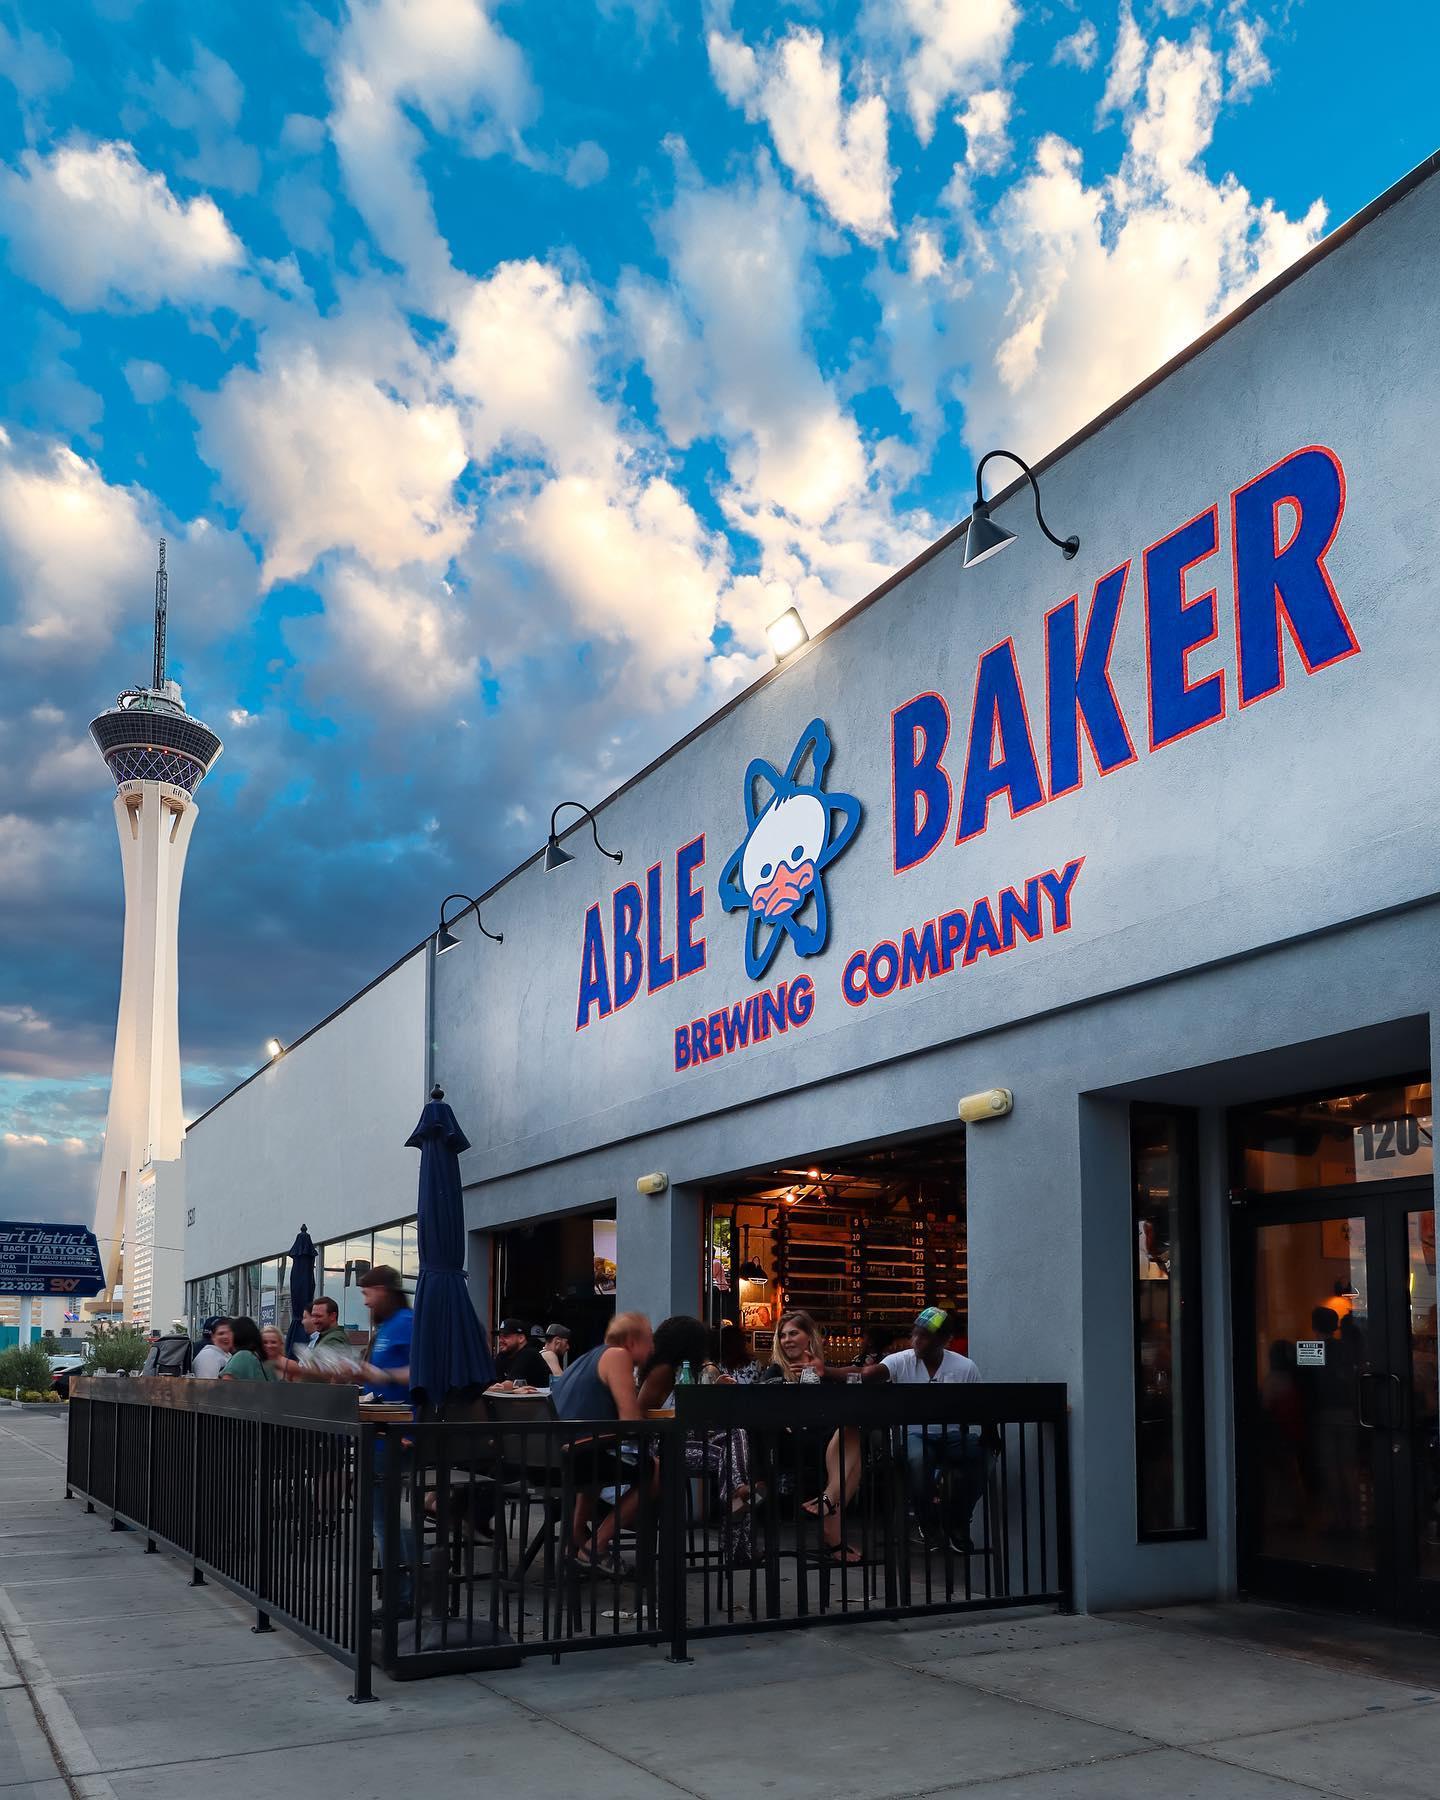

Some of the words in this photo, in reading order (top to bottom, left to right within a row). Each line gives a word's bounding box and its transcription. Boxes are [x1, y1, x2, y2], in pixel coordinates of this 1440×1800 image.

[576, 833, 707, 1031] ABLE
[891, 444, 1362, 875] BAKER
[674, 974, 815, 1072] BREWING
[841, 856, 1086, 1006] COMPANY
[1358, 1114, 1420, 1161] 120
[28, 1231, 87, 1245] district
[852, 1233, 861, 1241] 10
[915, 1237, 924, 1246] 19
[35, 1245, 93, 1256] TATTOOS
[852, 1249, 861, 1257] 11
[915, 1252, 924, 1261] 20
[852, 1265, 861, 1273] 12
[916, 1267, 924, 1276] 21
[852, 1280, 861, 1289] 14
[916, 1282, 925, 1291] 22
[852, 1296, 861, 1304] 15
[916, 1298, 925, 1306] 23
[852, 1312, 861, 1320] 16
[853, 1326, 861, 1335] 17
